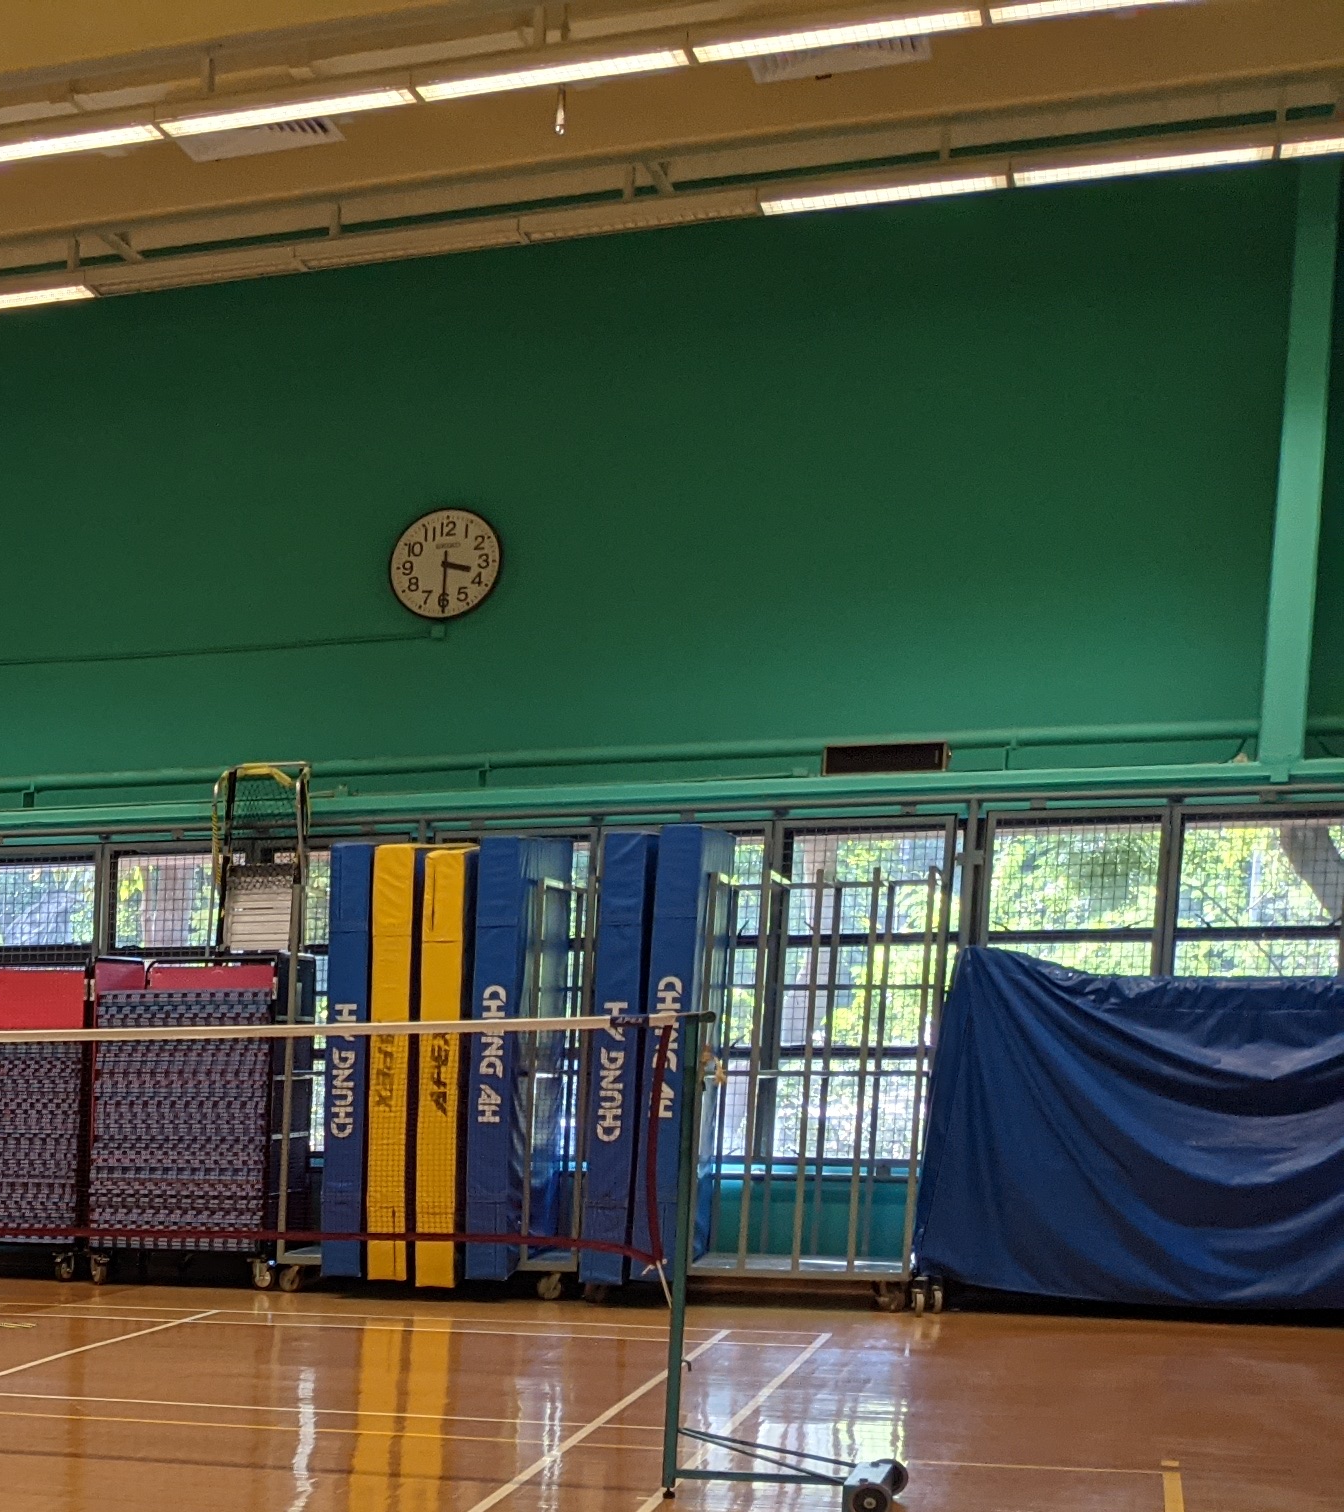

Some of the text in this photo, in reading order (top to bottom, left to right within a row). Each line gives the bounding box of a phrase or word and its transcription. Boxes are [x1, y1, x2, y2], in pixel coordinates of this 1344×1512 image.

[424, 526, 436, 542] 11
[440, 521, 456, 537] 12
[407, 542, 423, 557] 10
[474, 535, 485, 550] 2
[402, 560, 413, 576] 9
[477, 554, 490, 569] 3
[408, 577, 419, 592] 8
[471, 571, 483, 587] 4
[422, 590, 433, 605] 7
[457, 587, 468, 602] 5
[652, 976, 683, 1072] CHNG
[330, 1047, 355, 1138] CHUNG
[597, 1047, 625, 1142] CHUNG
[477, 1084, 502, 1123] AH
